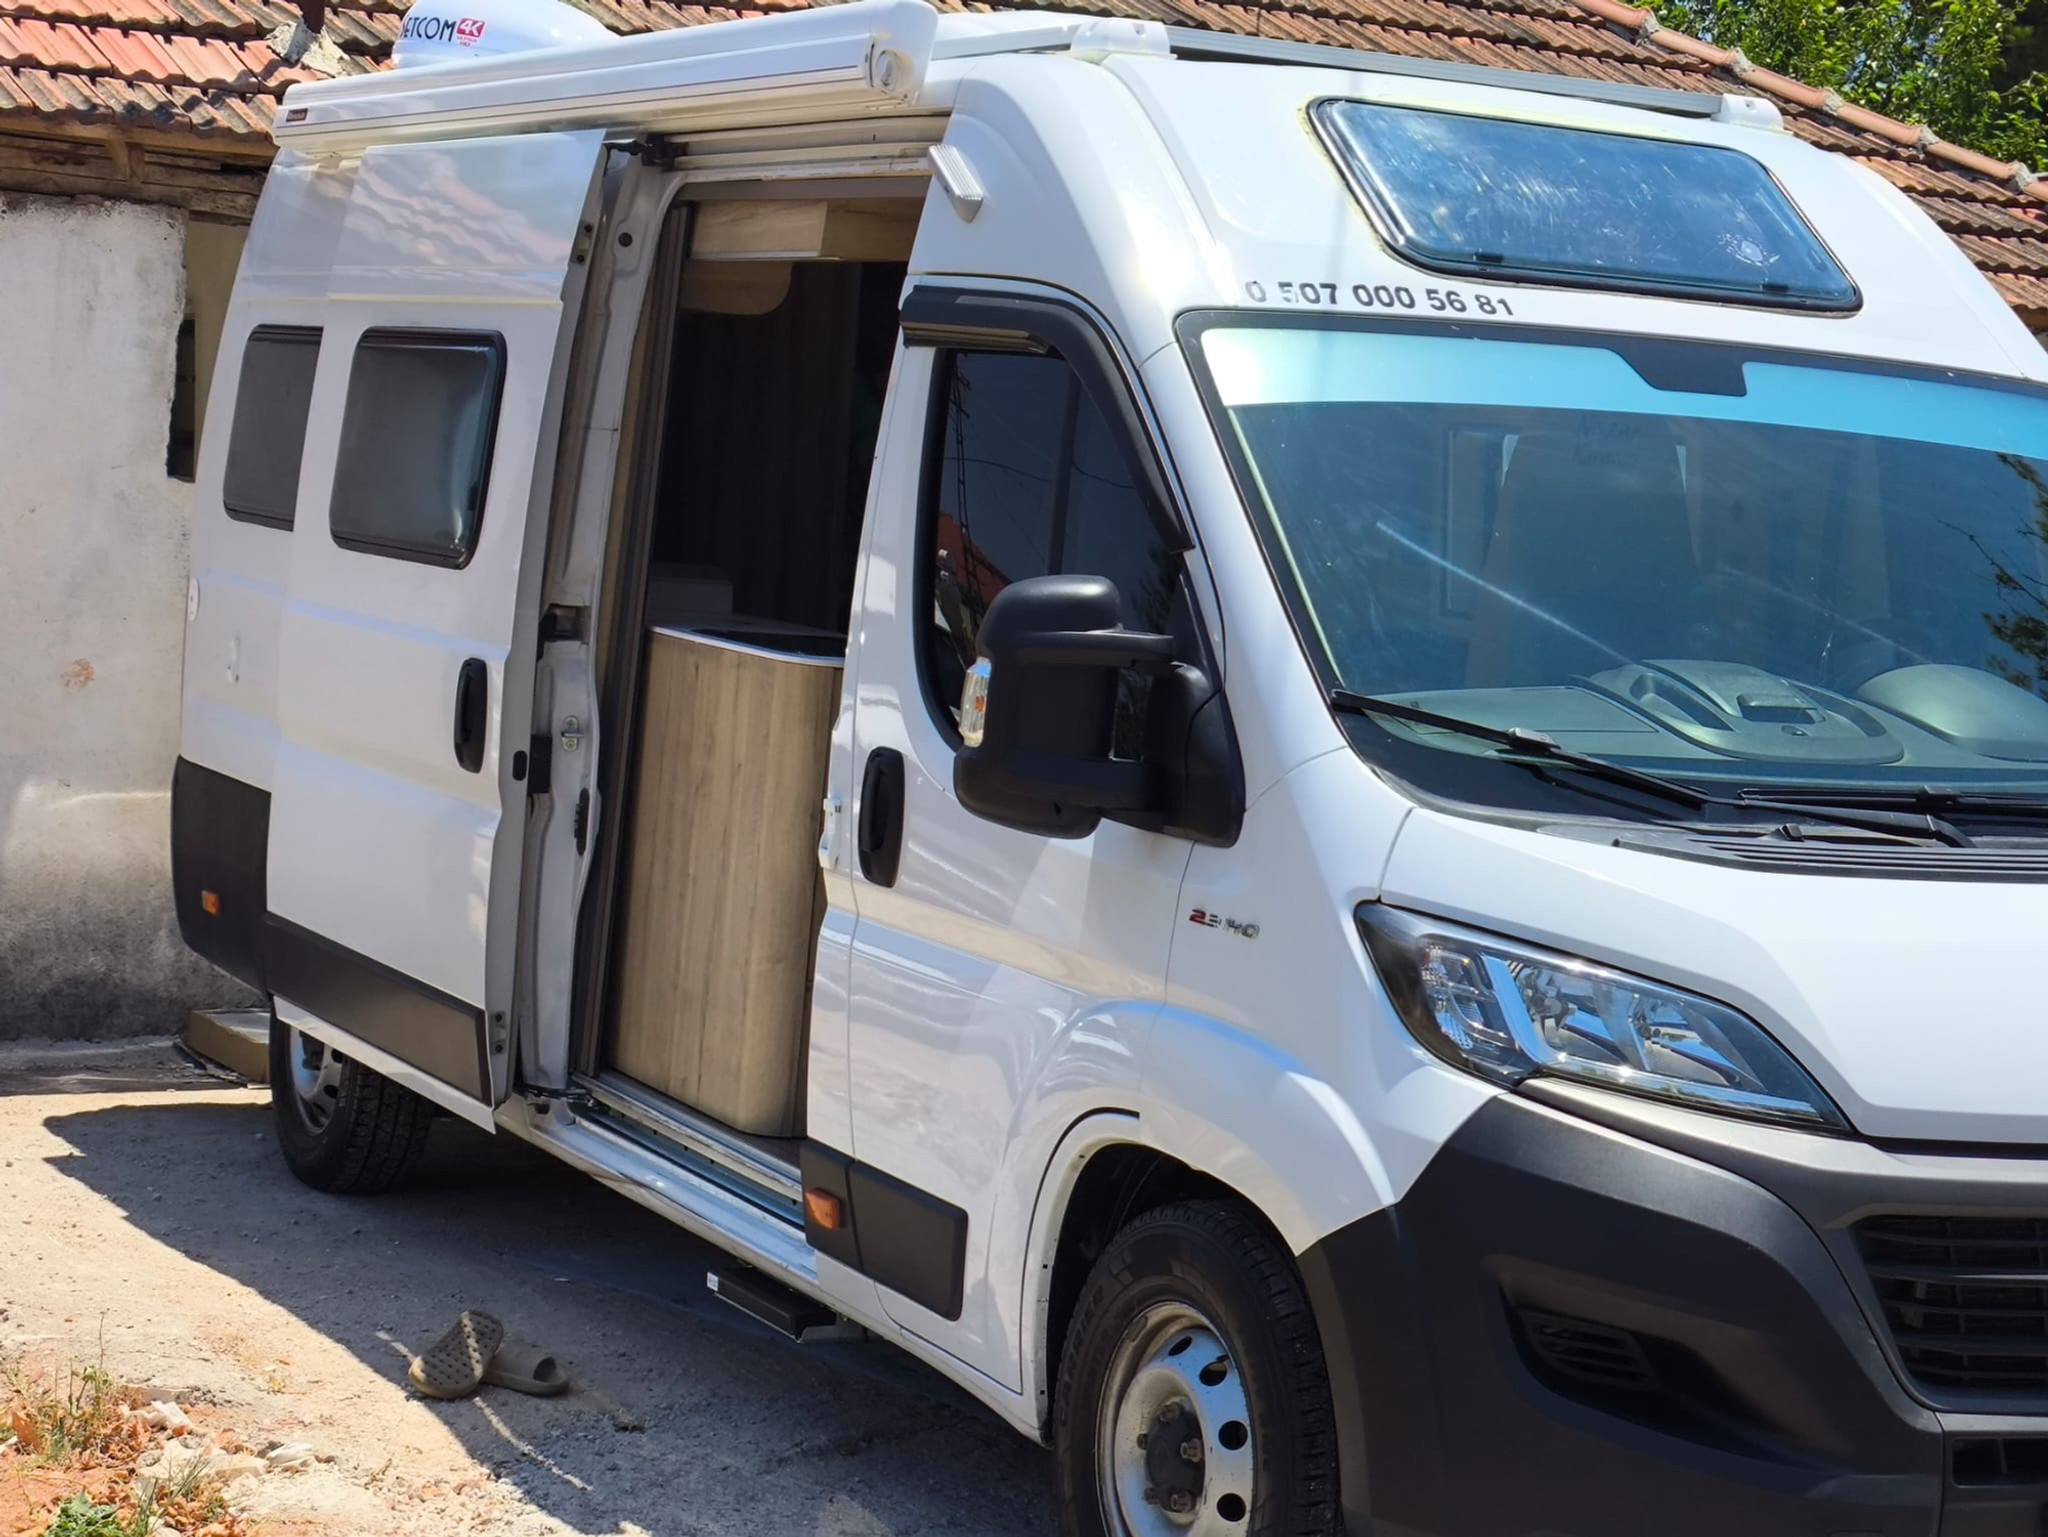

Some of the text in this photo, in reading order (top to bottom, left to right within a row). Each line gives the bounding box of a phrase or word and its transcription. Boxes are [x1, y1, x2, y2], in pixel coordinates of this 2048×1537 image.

[459, 19, 484, 36] 4K
[1245, 281, 1514, 316] 0 507 000 56 81
